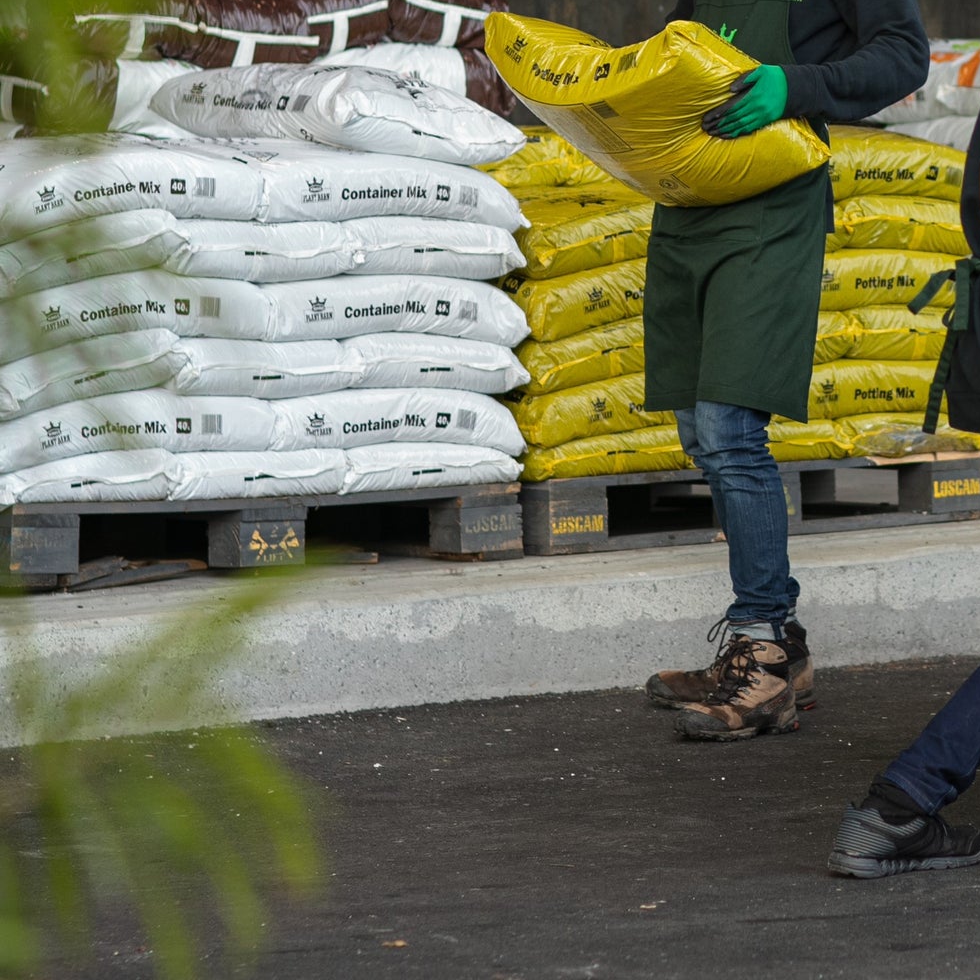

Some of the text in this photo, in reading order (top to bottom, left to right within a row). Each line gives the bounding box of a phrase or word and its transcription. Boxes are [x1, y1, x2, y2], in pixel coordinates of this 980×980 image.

[854, 169, 894, 183] Potting
[139, 181, 161, 194] Mix
[341, 187, 403, 201] Container
[406, 186, 427, 199] Mix
[855, 275, 915, 290] Potting Mix
[80, 302, 142, 322] Container
[145, 300, 166, 314] Mix
[405, 300, 426, 314] Mix
[854, 386, 915, 401] Potting Mix
[404, 414, 426, 427] Mix
[81, 420, 141, 438] Container
[144, 420, 167, 434] Mix
[932, 478, 980, 499] LOSCAM
[551, 514, 604, 535] LOSCAM
